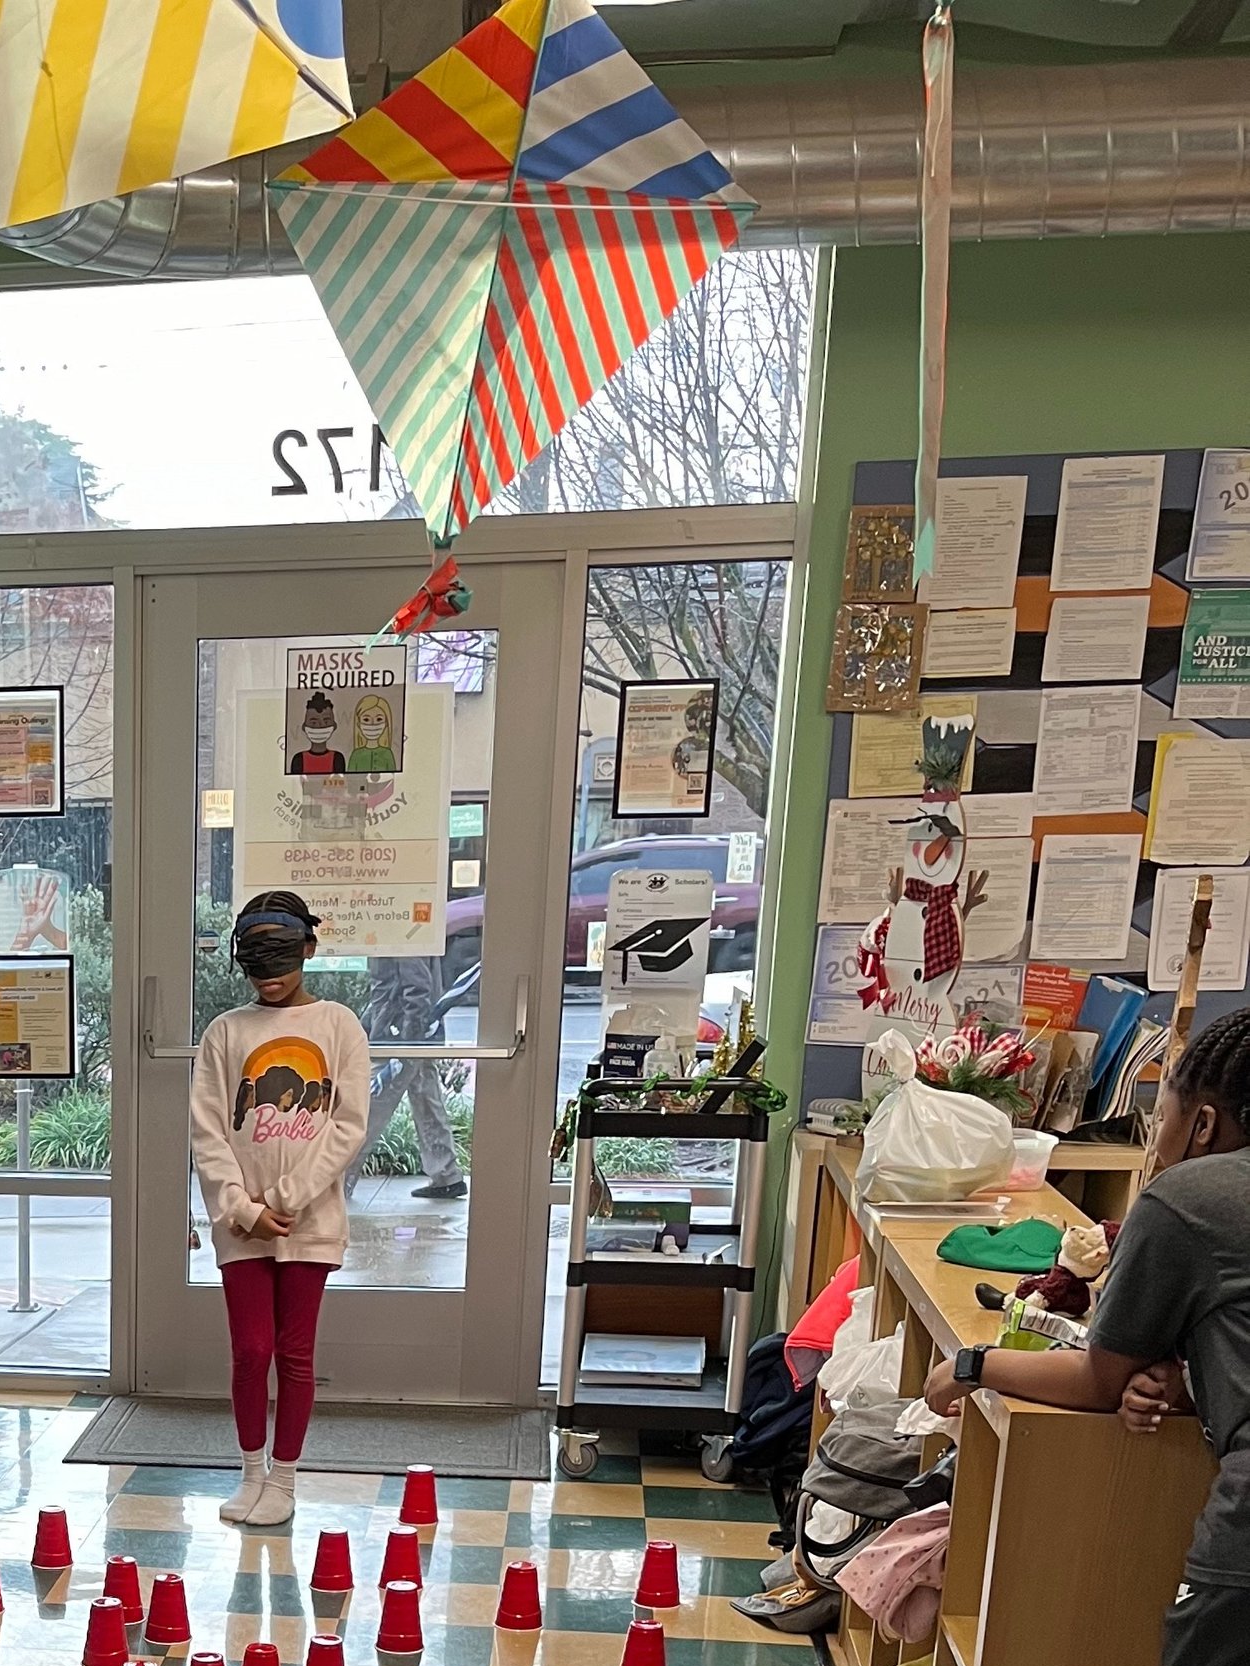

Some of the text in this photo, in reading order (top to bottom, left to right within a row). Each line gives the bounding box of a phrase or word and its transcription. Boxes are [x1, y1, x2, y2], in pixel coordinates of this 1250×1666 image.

[1195, 635, 1227, 646] AND
[297, 651, 364, 671] MASKS
[1208, 657, 1238, 668] ALL
[297, 670, 395, 690] REQUIRED
[675, 878, 708, 886] Scholars!
[890, 985, 944, 1037] Merry
[616, 1043, 655, 1051] MADE IN US
[252, 1104, 316, 1144] Barbie
